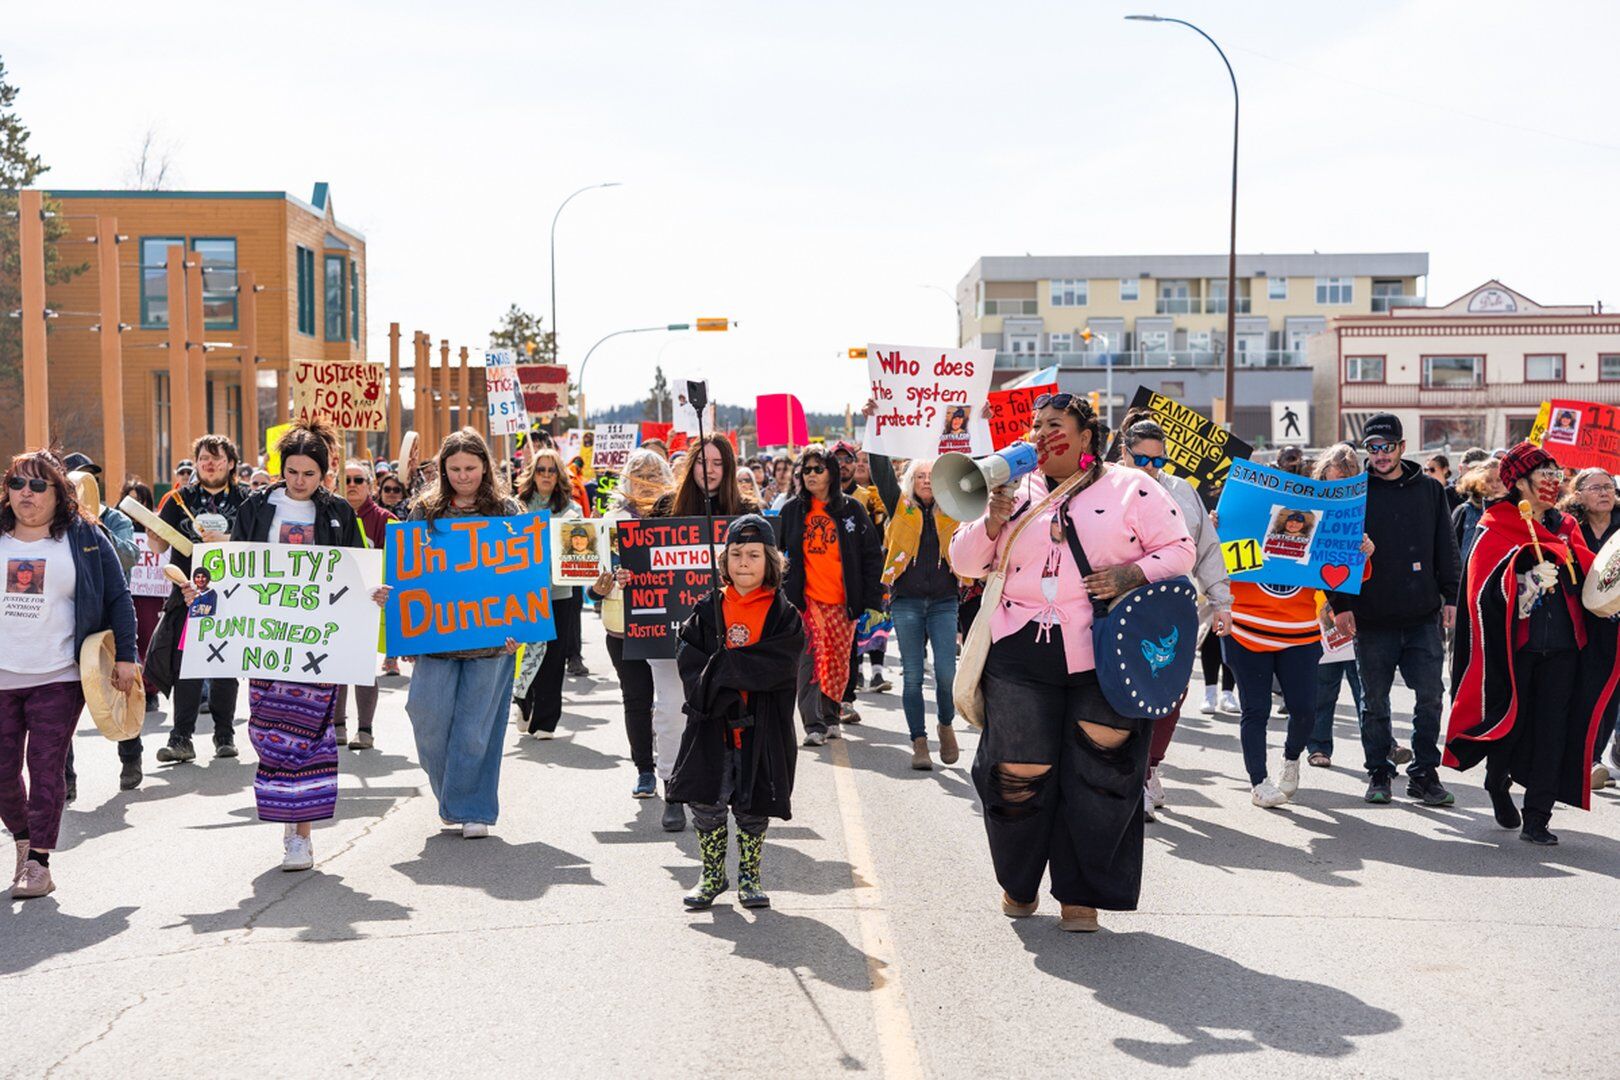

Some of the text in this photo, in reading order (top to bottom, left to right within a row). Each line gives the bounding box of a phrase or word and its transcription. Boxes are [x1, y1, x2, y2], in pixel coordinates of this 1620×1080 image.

[876, 350, 975, 377] Who does
[314, 388, 353, 410] FOR
[871, 378, 968, 408] the system
[875, 405, 936, 436] protect?
[1151, 412, 1223, 462] SERVING
[1210, 425, 1227, 445] IS
[1232, 465, 1367, 499] STAND FOR JUSTICE
[396, 515, 547, 580] Un Just
[619, 520, 700, 549] JUSTICE
[202, 548, 342, 582] GUILTY?
[1310, 550, 1366, 567] MISSED
[6, 603, 42, 611] ANTHONY
[249, 582, 320, 610] YES
[631, 588, 669, 608] NOT
[198, 616, 340, 645] PUNISHED?
[627, 623, 667, 638] JUSTICE
[242, 646, 293, 673] NO!
